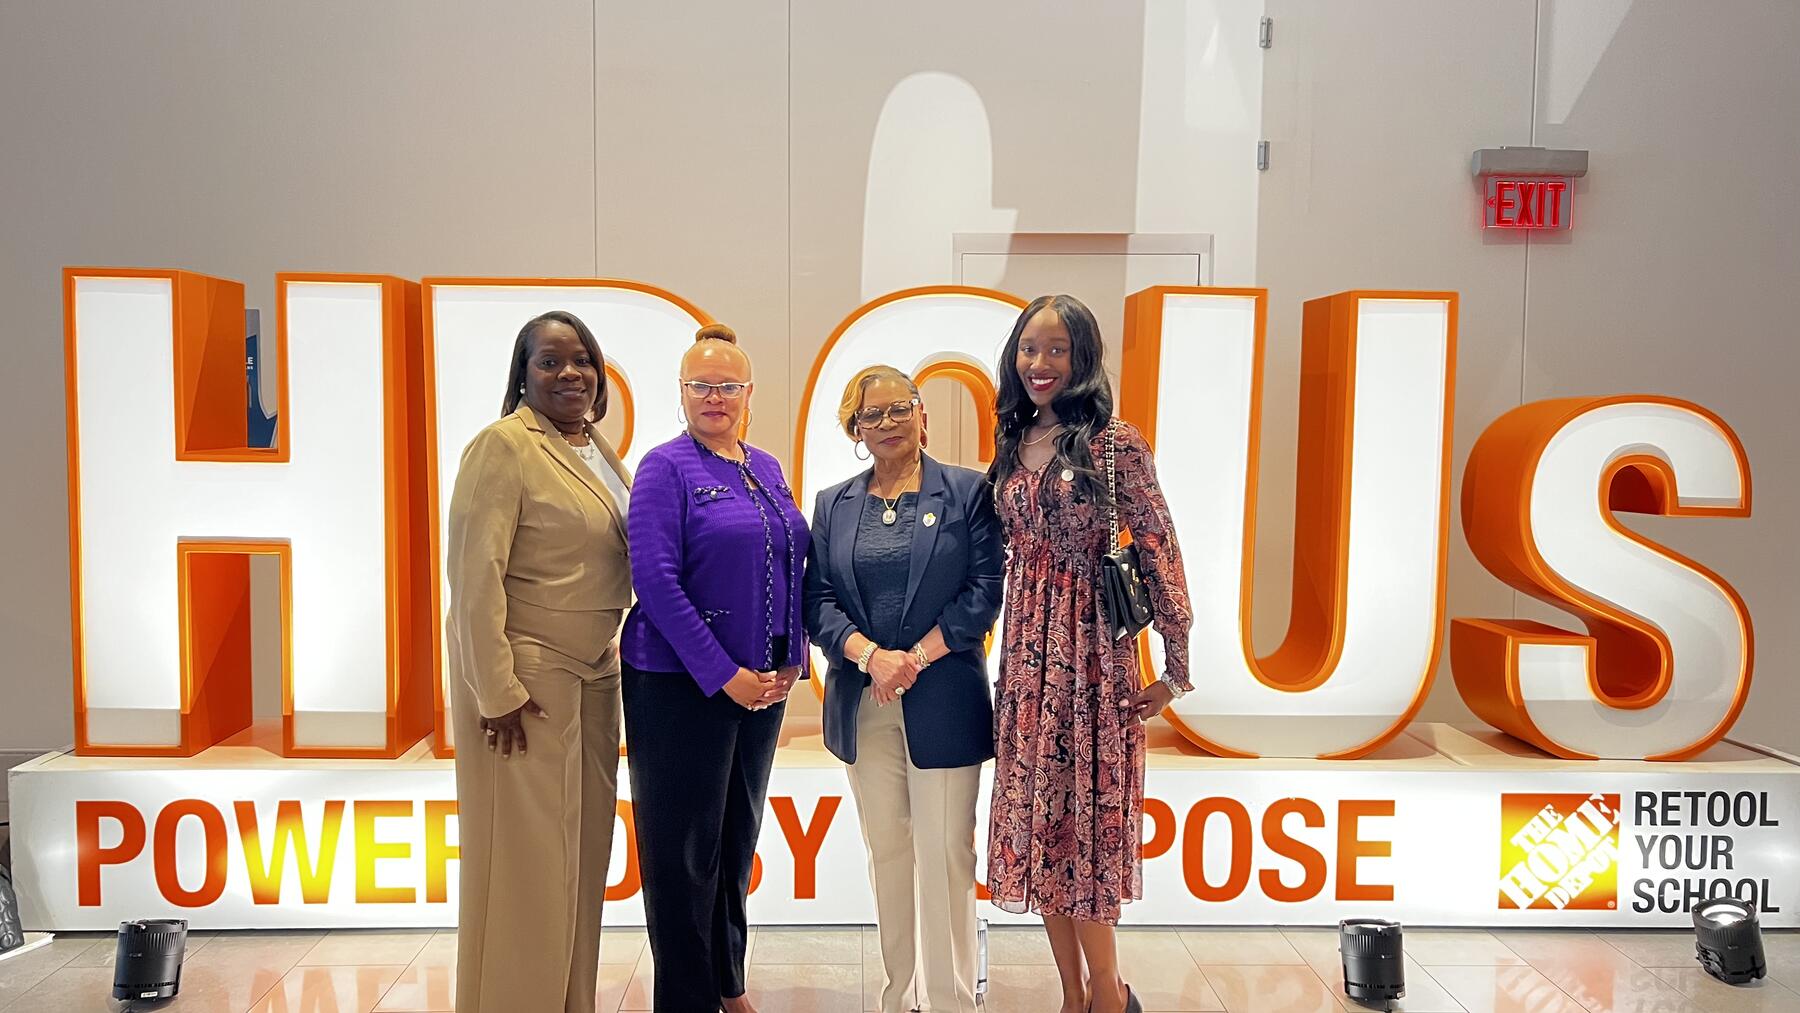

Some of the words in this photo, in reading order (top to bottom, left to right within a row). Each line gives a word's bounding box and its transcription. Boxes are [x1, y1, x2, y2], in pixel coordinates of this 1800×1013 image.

[1495, 181, 1566, 227] EXIT
[1509, 803, 1564, 853] THE
[1634, 790, 1779, 827] RETOOL
[75, 798, 642, 908] POWE
[748, 796, 843, 900] Y
[974, 796, 1396, 903] POSE
[1499, 793, 1620, 910] HOME
[1543, 835, 1618, 910] DEPOT
[1634, 834, 1735, 870] YOUR
[1632, 878, 1780, 913] SCHOOL
